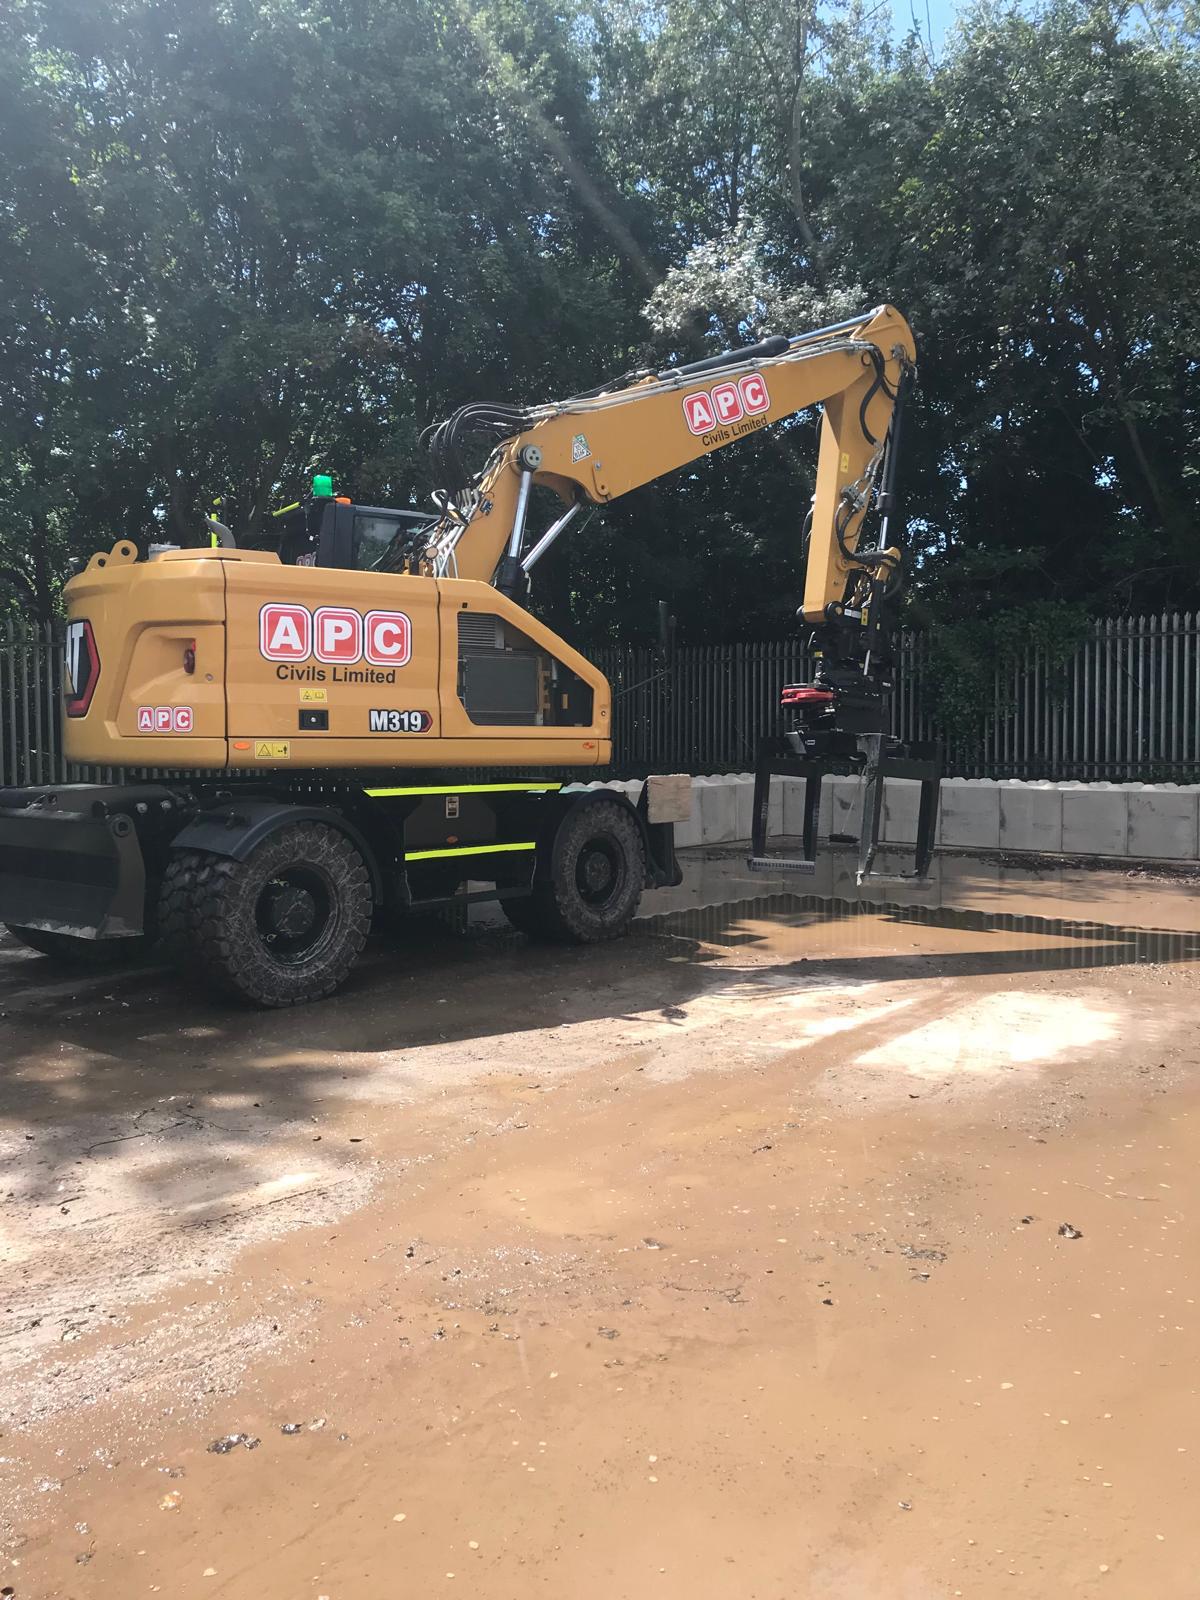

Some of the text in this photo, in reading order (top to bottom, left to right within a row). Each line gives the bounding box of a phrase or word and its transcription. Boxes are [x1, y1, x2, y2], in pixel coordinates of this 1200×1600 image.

[692, 382, 764, 428] APC
[702, 415, 767, 446] Civils Limited
[267, 614, 403, 657] APC
[276, 664, 396, 684] Civils Limited
[140, 710, 190, 728] APC
[369, 710, 422, 732] M319
